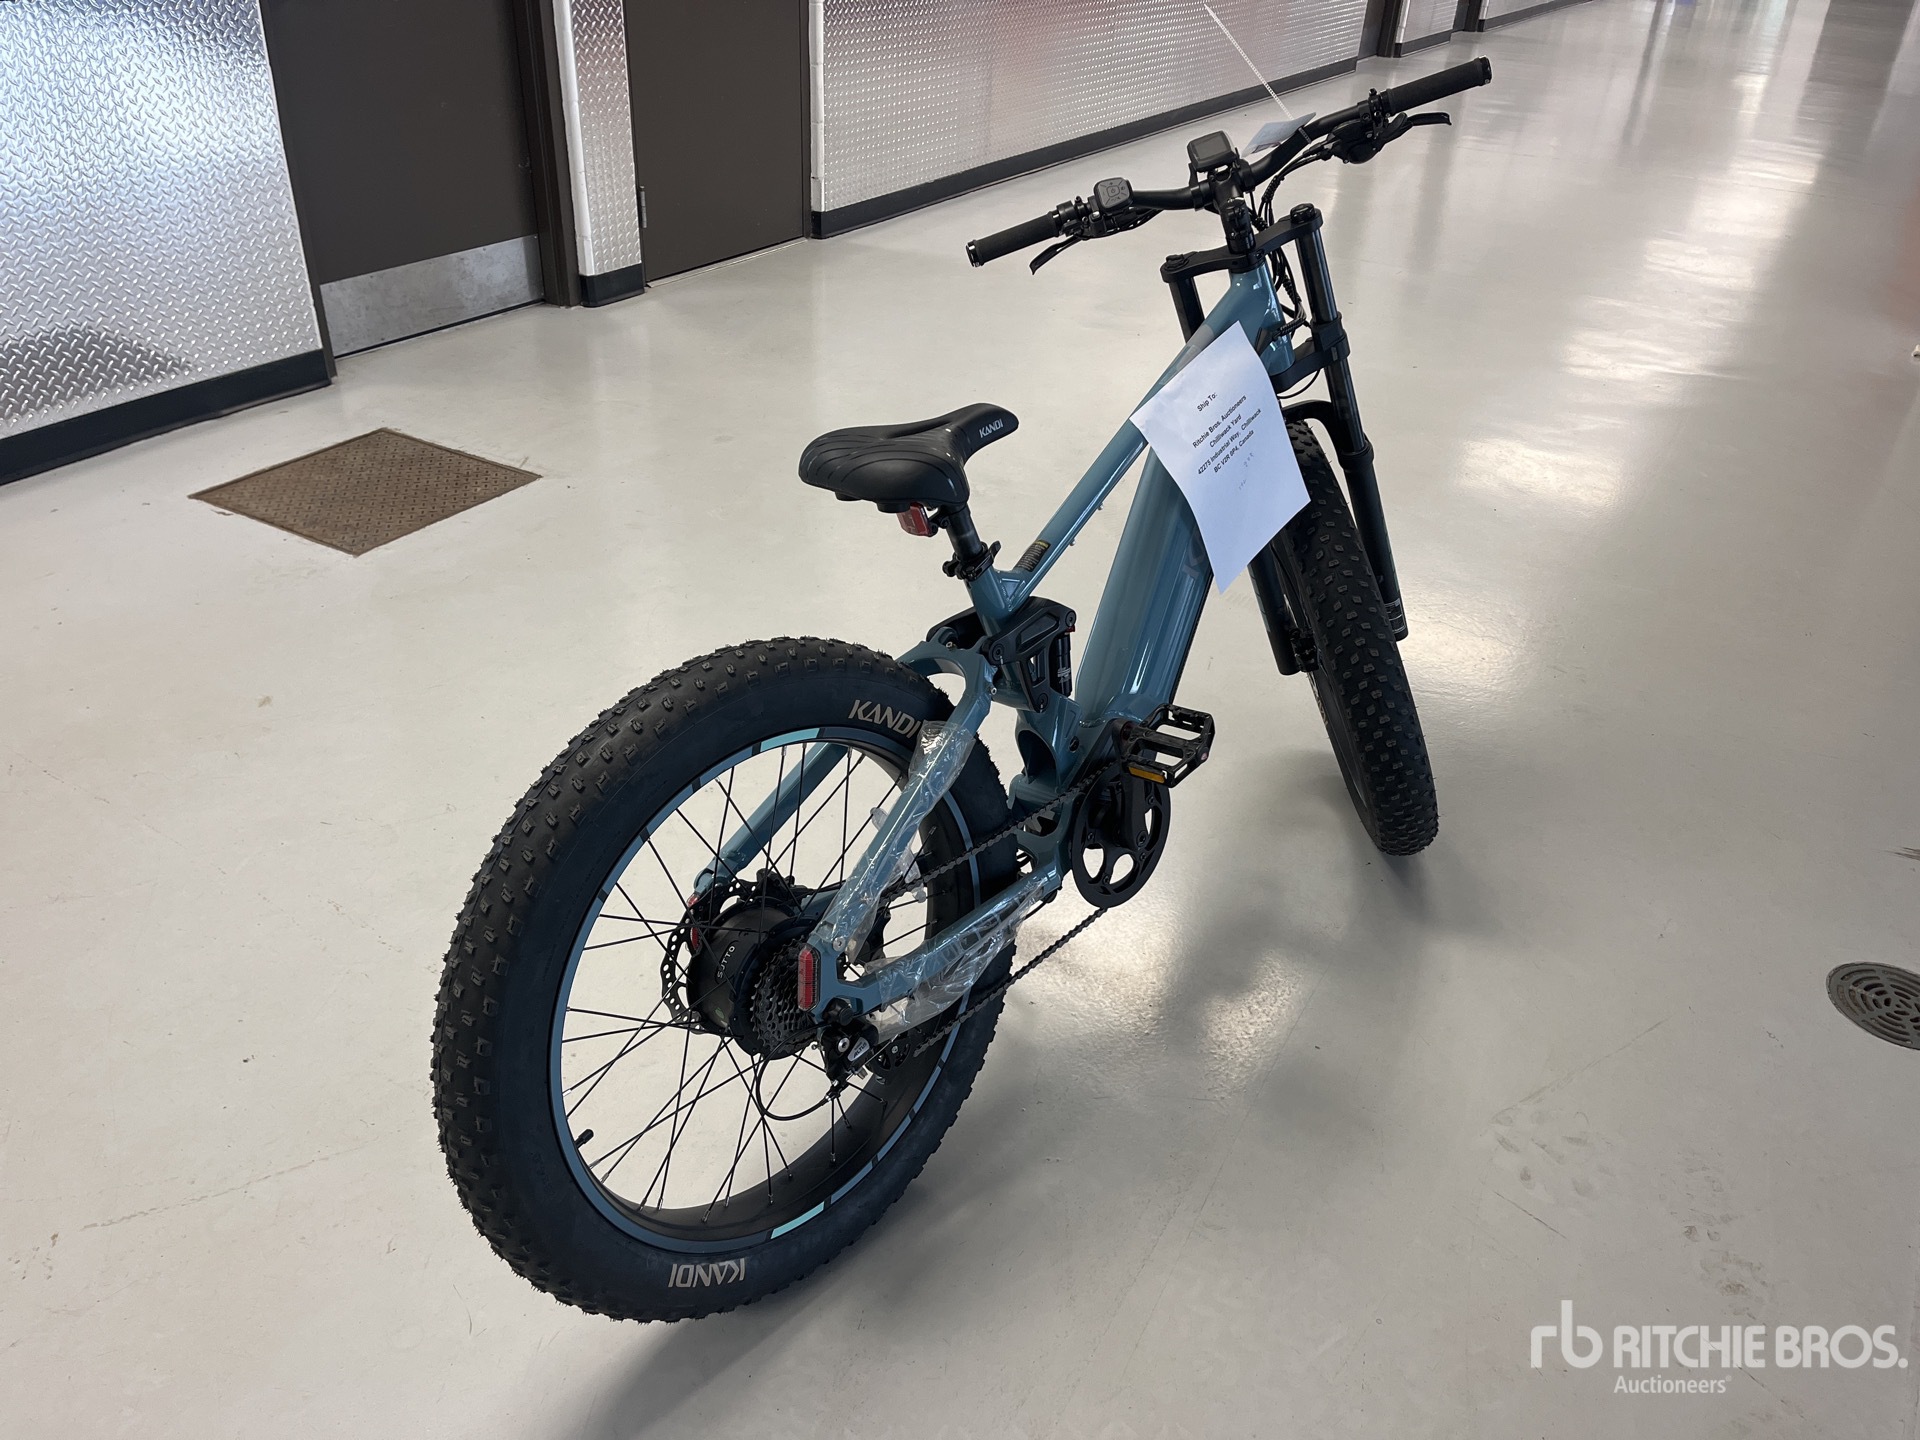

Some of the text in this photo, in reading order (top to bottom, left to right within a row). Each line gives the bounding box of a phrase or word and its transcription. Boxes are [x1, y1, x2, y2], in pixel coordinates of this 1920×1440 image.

[1197, 392, 1218, 412] Ship To:
[979, 418, 1003, 438] KANDI
[1192, 395, 1247, 449] Ritchie Bros. Auctioneers
[1209, 414, 1242, 448] Chilliwack Yard
[1213, 462, 1222, 474] BC
[848, 700, 921, 738] KANDI
[668, 1258, 746, 1288] KANDI
